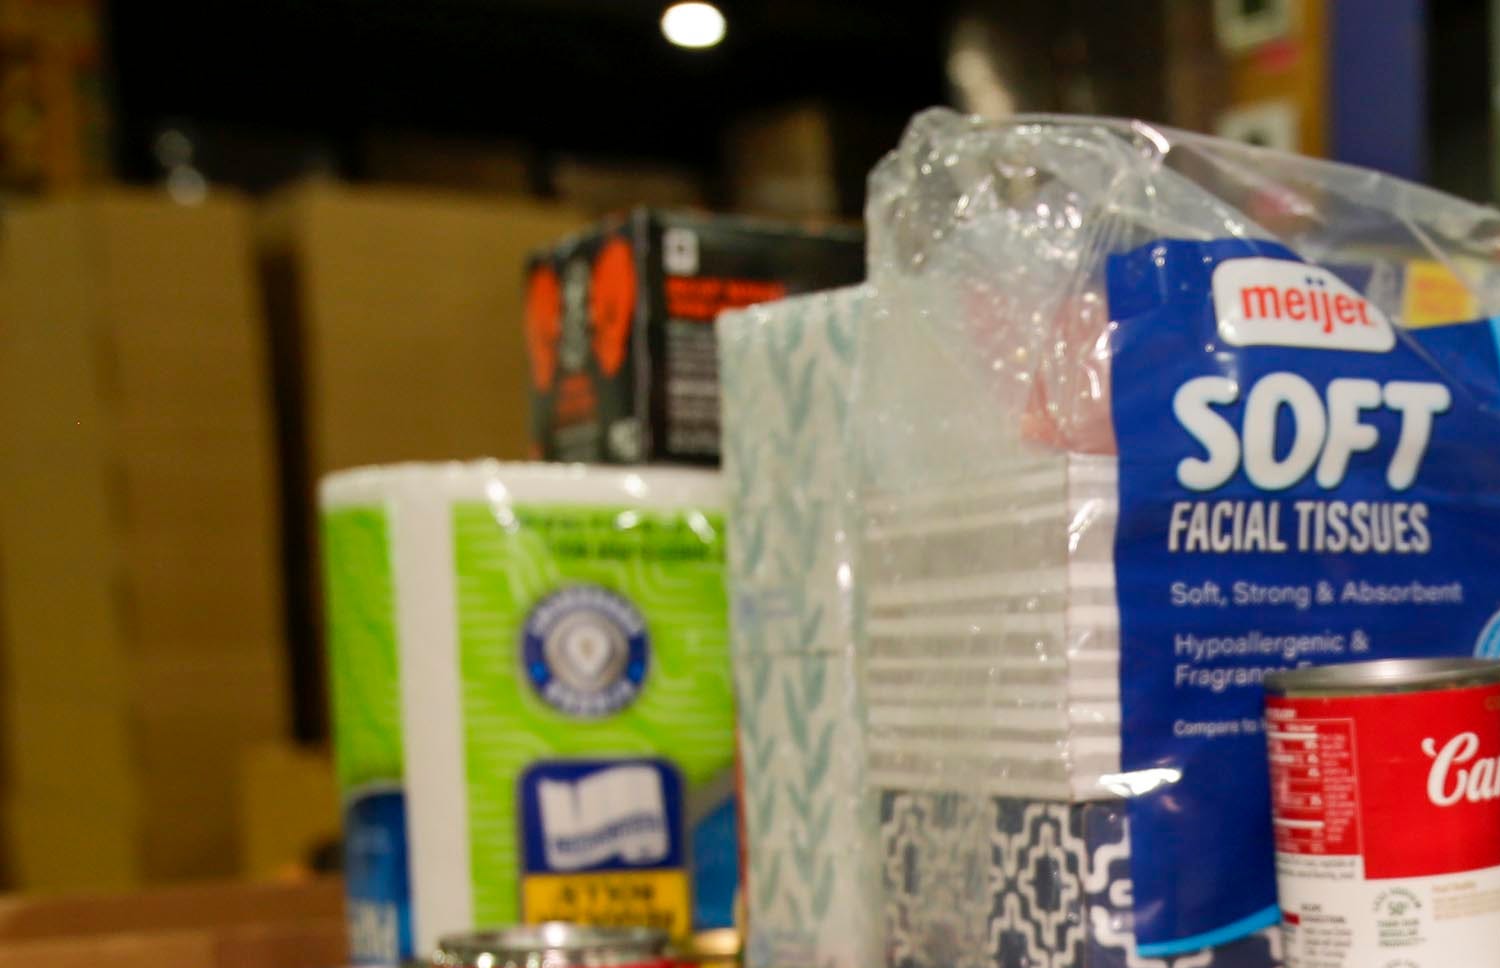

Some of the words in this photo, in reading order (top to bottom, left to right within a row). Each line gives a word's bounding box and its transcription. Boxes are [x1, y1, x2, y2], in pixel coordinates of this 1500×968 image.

[1240, 275, 1373, 334] meijer
[1172, 371, 1452, 491] SOFT
[1168, 502, 1288, 553] FACIAL
[1295, 502, 1431, 553] TISSUES
[1170, 581, 1227, 607] Soft,
[1232, 581, 1312, 609] Strong
[1315, 581, 1334, 603] &
[1342, 580, 1462, 603] Absorbent
[1174, 631, 1344, 660] Hypoallergenic
[1351, 630, 1370, 651] &
[1173, 719, 1239, 737] Compare
[1242, 720, 1258, 732] to
